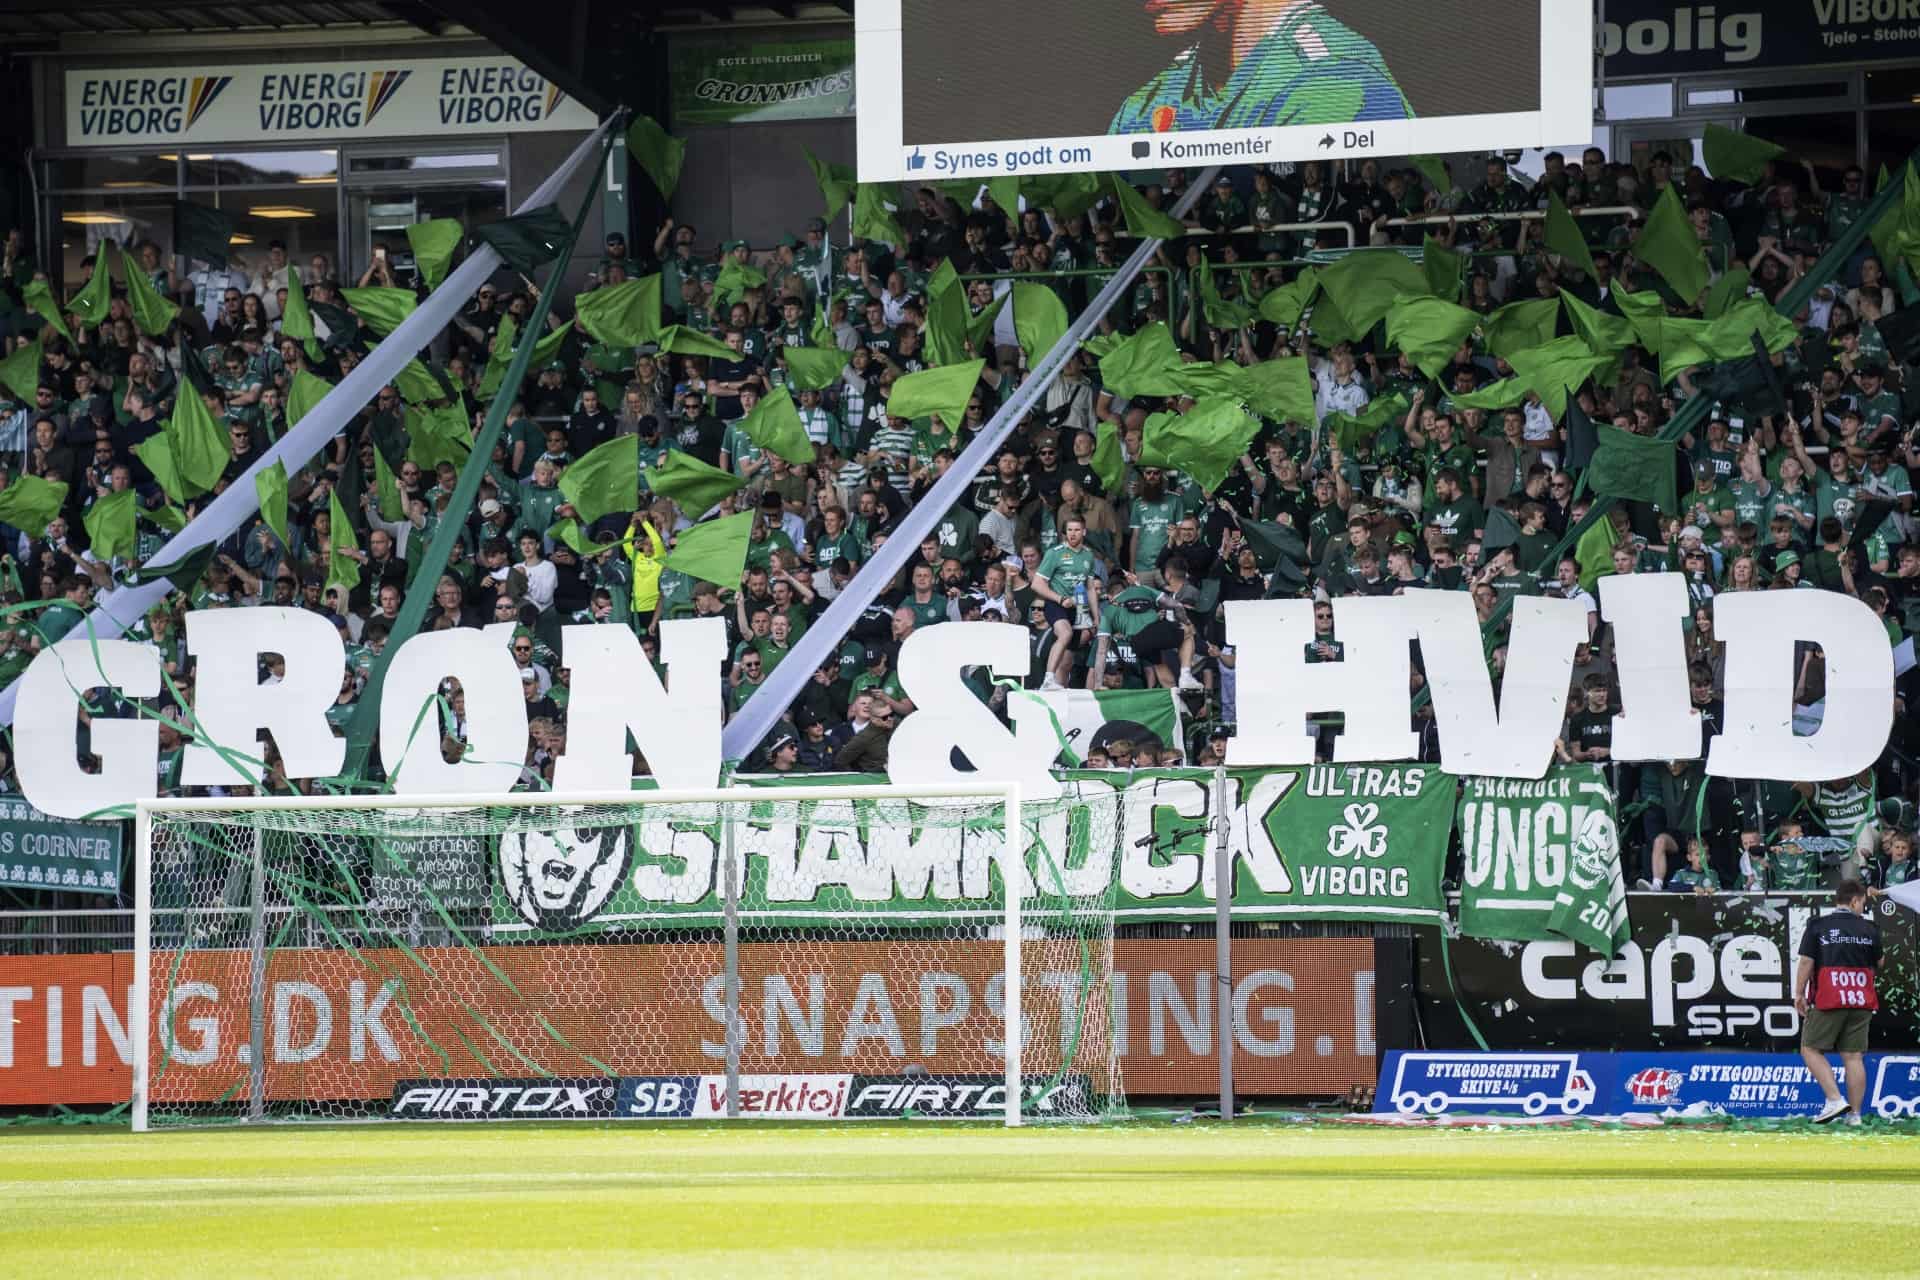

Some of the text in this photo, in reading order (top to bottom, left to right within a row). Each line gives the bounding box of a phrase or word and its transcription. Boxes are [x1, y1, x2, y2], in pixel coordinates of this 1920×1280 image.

[81, 77, 188, 107] ENERGI
[260, 71, 367, 101] ENERGI
[439, 66, 545, 95] ENERGI
[80, 106, 184, 136] VIBORG
[259, 102, 362, 131] VIBORG
[438, 94, 543, 124] VIBORG
[1160, 135, 1272, 160] Kommentér
[1343, 129, 1375, 149] Del
[933, 145, 1092, 175] Synes godt om
[1223, 572, 1896, 781] HVID
[1306, 767, 1425, 798] ULTRAS
[1474, 776, 1571, 798] SHAMROCK
[21, 833, 112, 861] CORNER
[633, 774, 1301, 904] SHAMROCK
[1300, 865, 1410, 897] VIBORG
[1521, 906, 1874, 1027] capel
[1830, 971, 1867, 988] FOTO
[1838, 990, 1866, 1006] 183
[1426, 1063, 1561, 1079] STYKGODSCENTRET
[1689, 1064, 1847, 1083] STYKGODSCENTT
[631, 1082, 683, 1113] SB
[1459, 1079, 1501, 1095] SKIVE
[1729, 1084, 1778, 1102] SKIVE
[1709, 1102, 1764, 1110] ANSPORT
